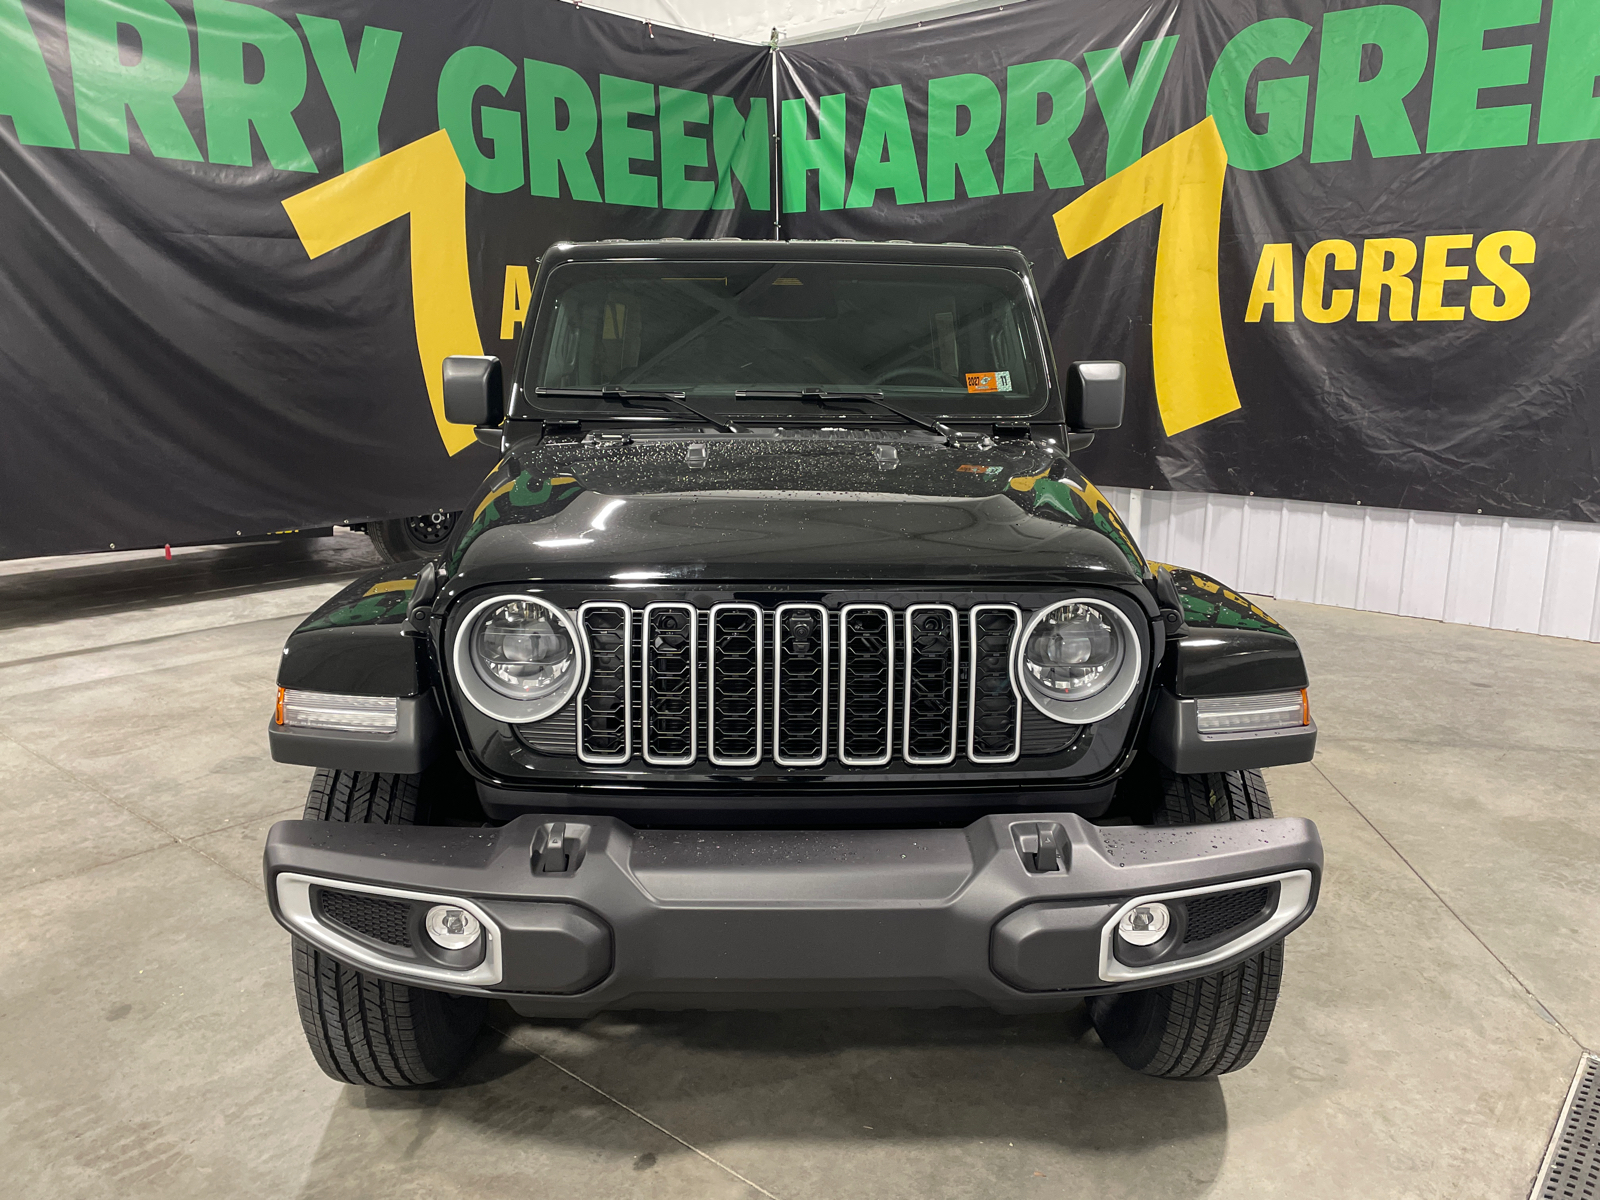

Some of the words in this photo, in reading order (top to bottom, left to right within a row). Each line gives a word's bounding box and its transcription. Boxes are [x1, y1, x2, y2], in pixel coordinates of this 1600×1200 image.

[437, 45, 771, 211] GREEN
[781, 35, 1179, 214] HARRY
[281, 128, 484, 457] 7
[1053, 115, 1241, 436] 7
[1244, 231, 1537, 323] ACRES
[967, 376, 980, 387] 2027
[1000, 375, 1008, 387] 11
